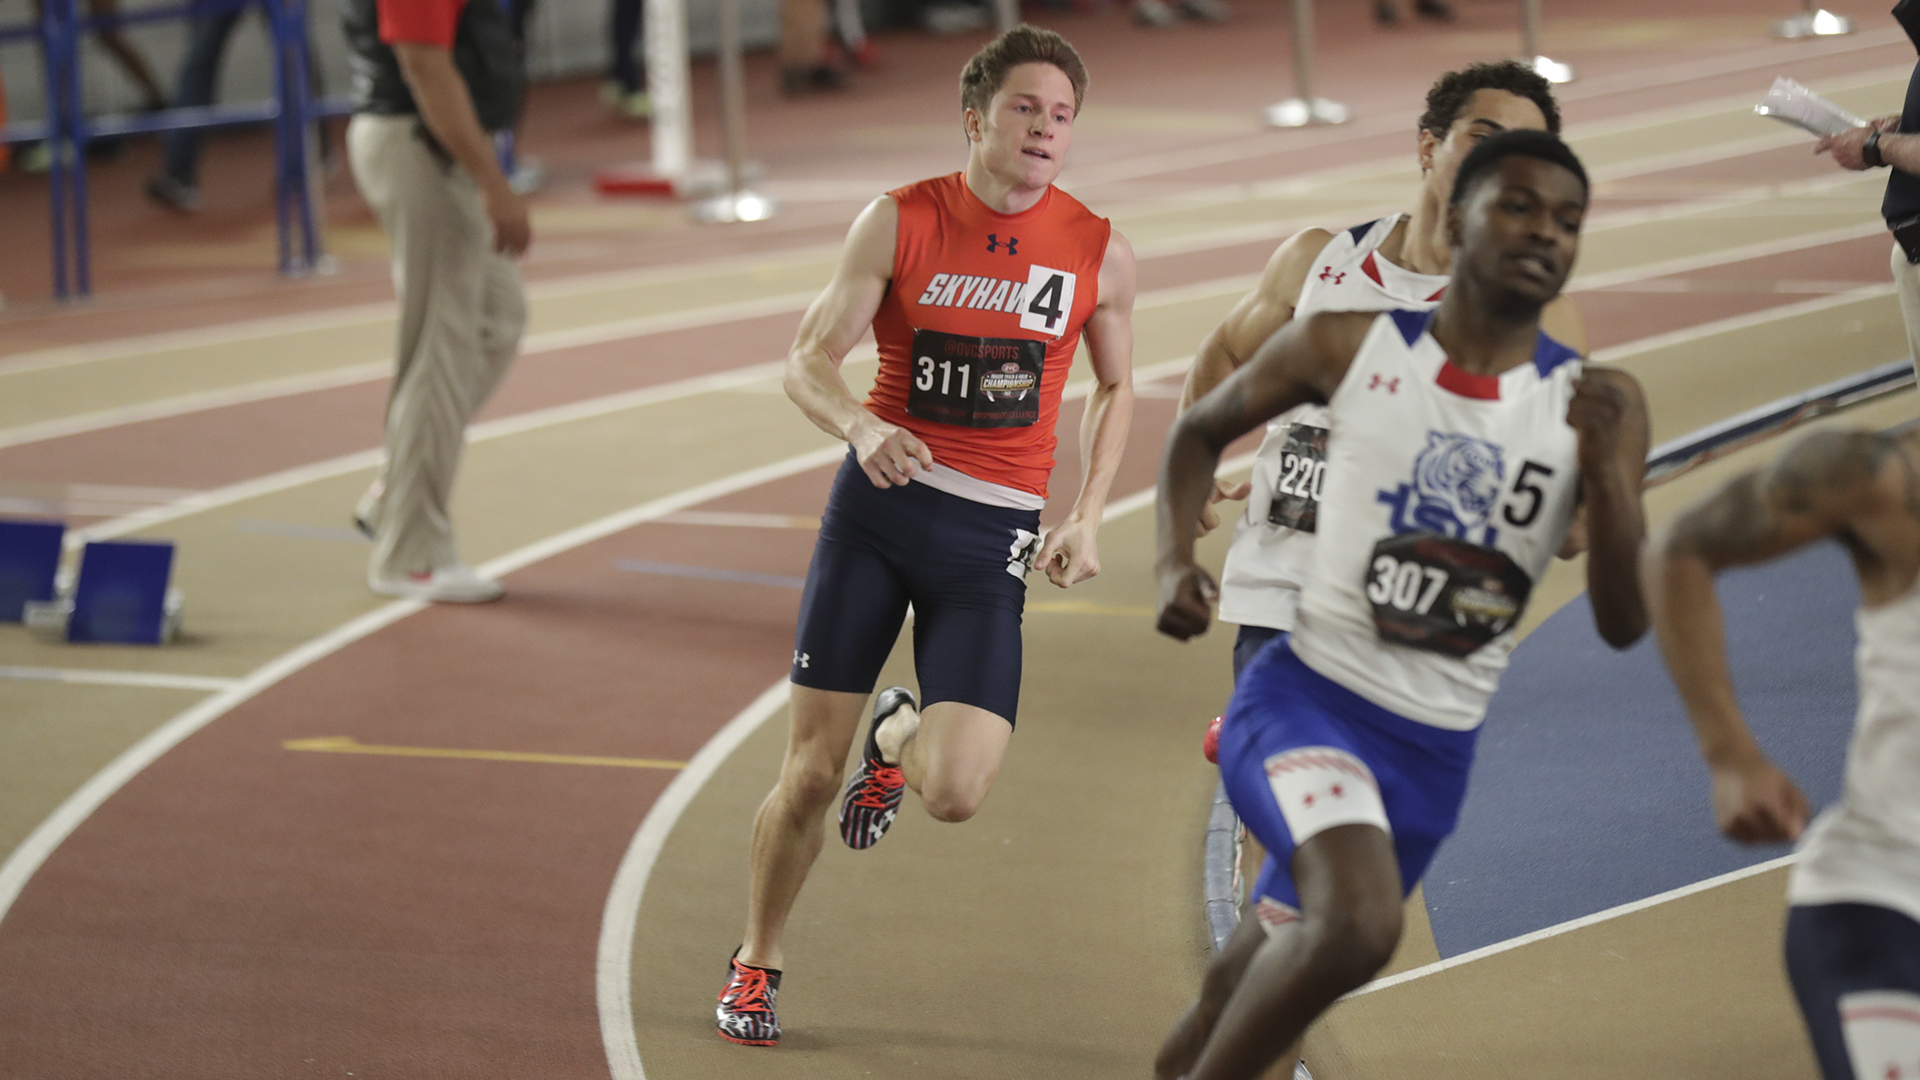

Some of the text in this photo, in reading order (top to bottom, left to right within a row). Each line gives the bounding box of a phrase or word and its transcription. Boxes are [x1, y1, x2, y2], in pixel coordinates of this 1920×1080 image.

[917, 272, 1027, 315] SKYHAW
[1028, 273, 1064, 329] 4
[945, 340, 1019, 359] @OVCSPORTS
[916, 356, 970, 398] 311
[983, 378, 1033, 388] CHAMPIONSHIP
[1280, 453, 1327, 502] 220
[1504, 461, 1554, 527] 5
[1367, 554, 1449, 615] 307
